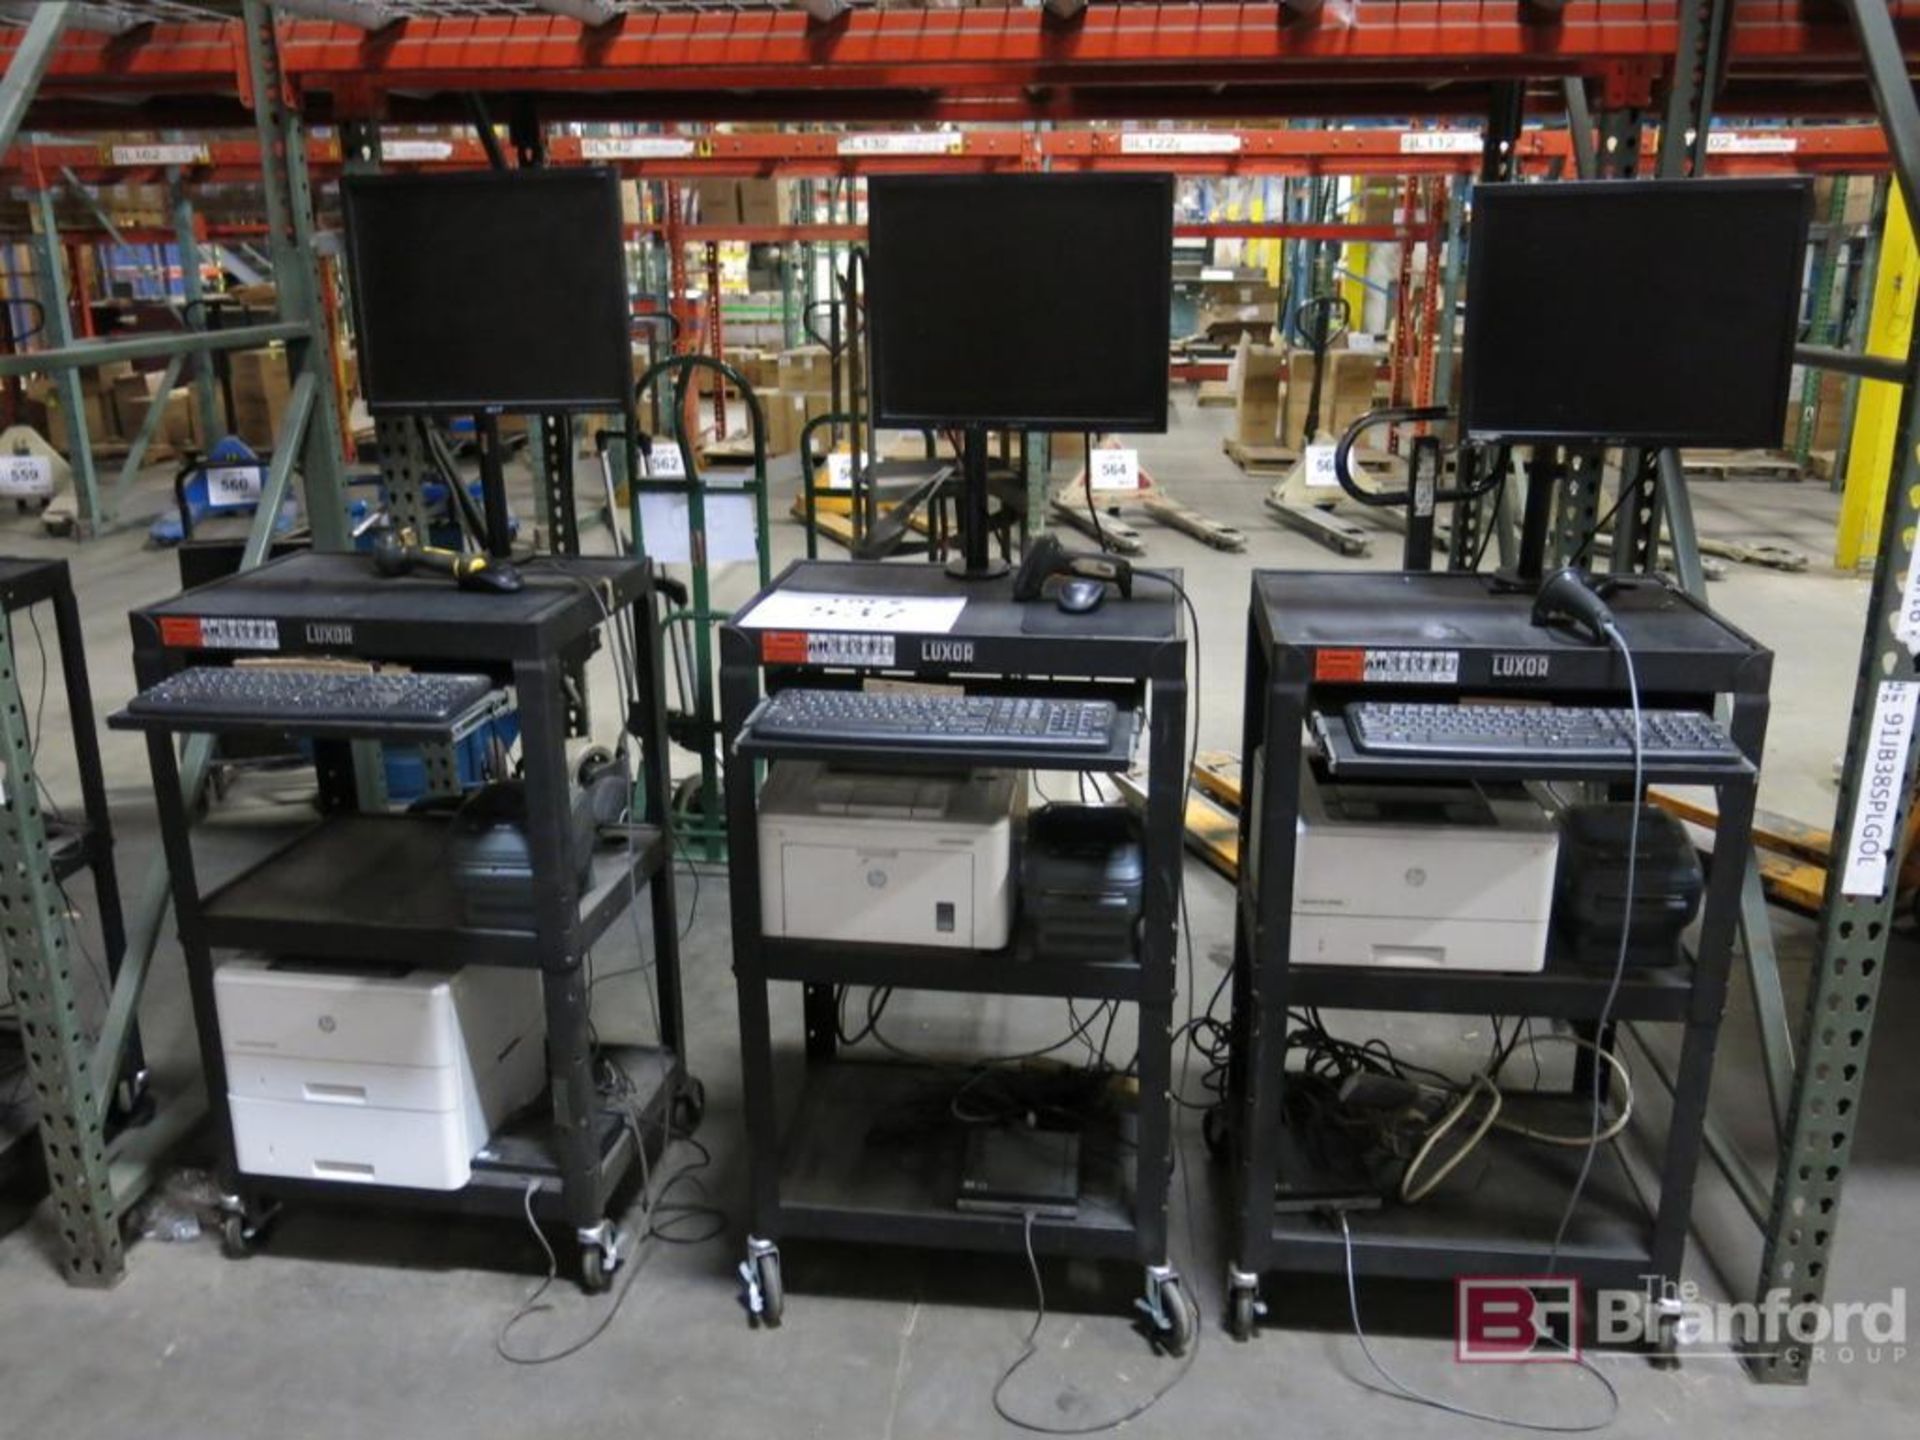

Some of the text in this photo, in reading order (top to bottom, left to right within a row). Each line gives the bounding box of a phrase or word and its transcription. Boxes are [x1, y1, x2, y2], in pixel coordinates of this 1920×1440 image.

[1101, 463, 1127, 477] 564
[1316, 459, 1336, 472] 56
[10, 469, 39, 482] 559
[306, 623, 355, 646] LUXOR
[921, 642, 975, 663] LUXOR
[1491, 655, 1549, 678] LUXOR
